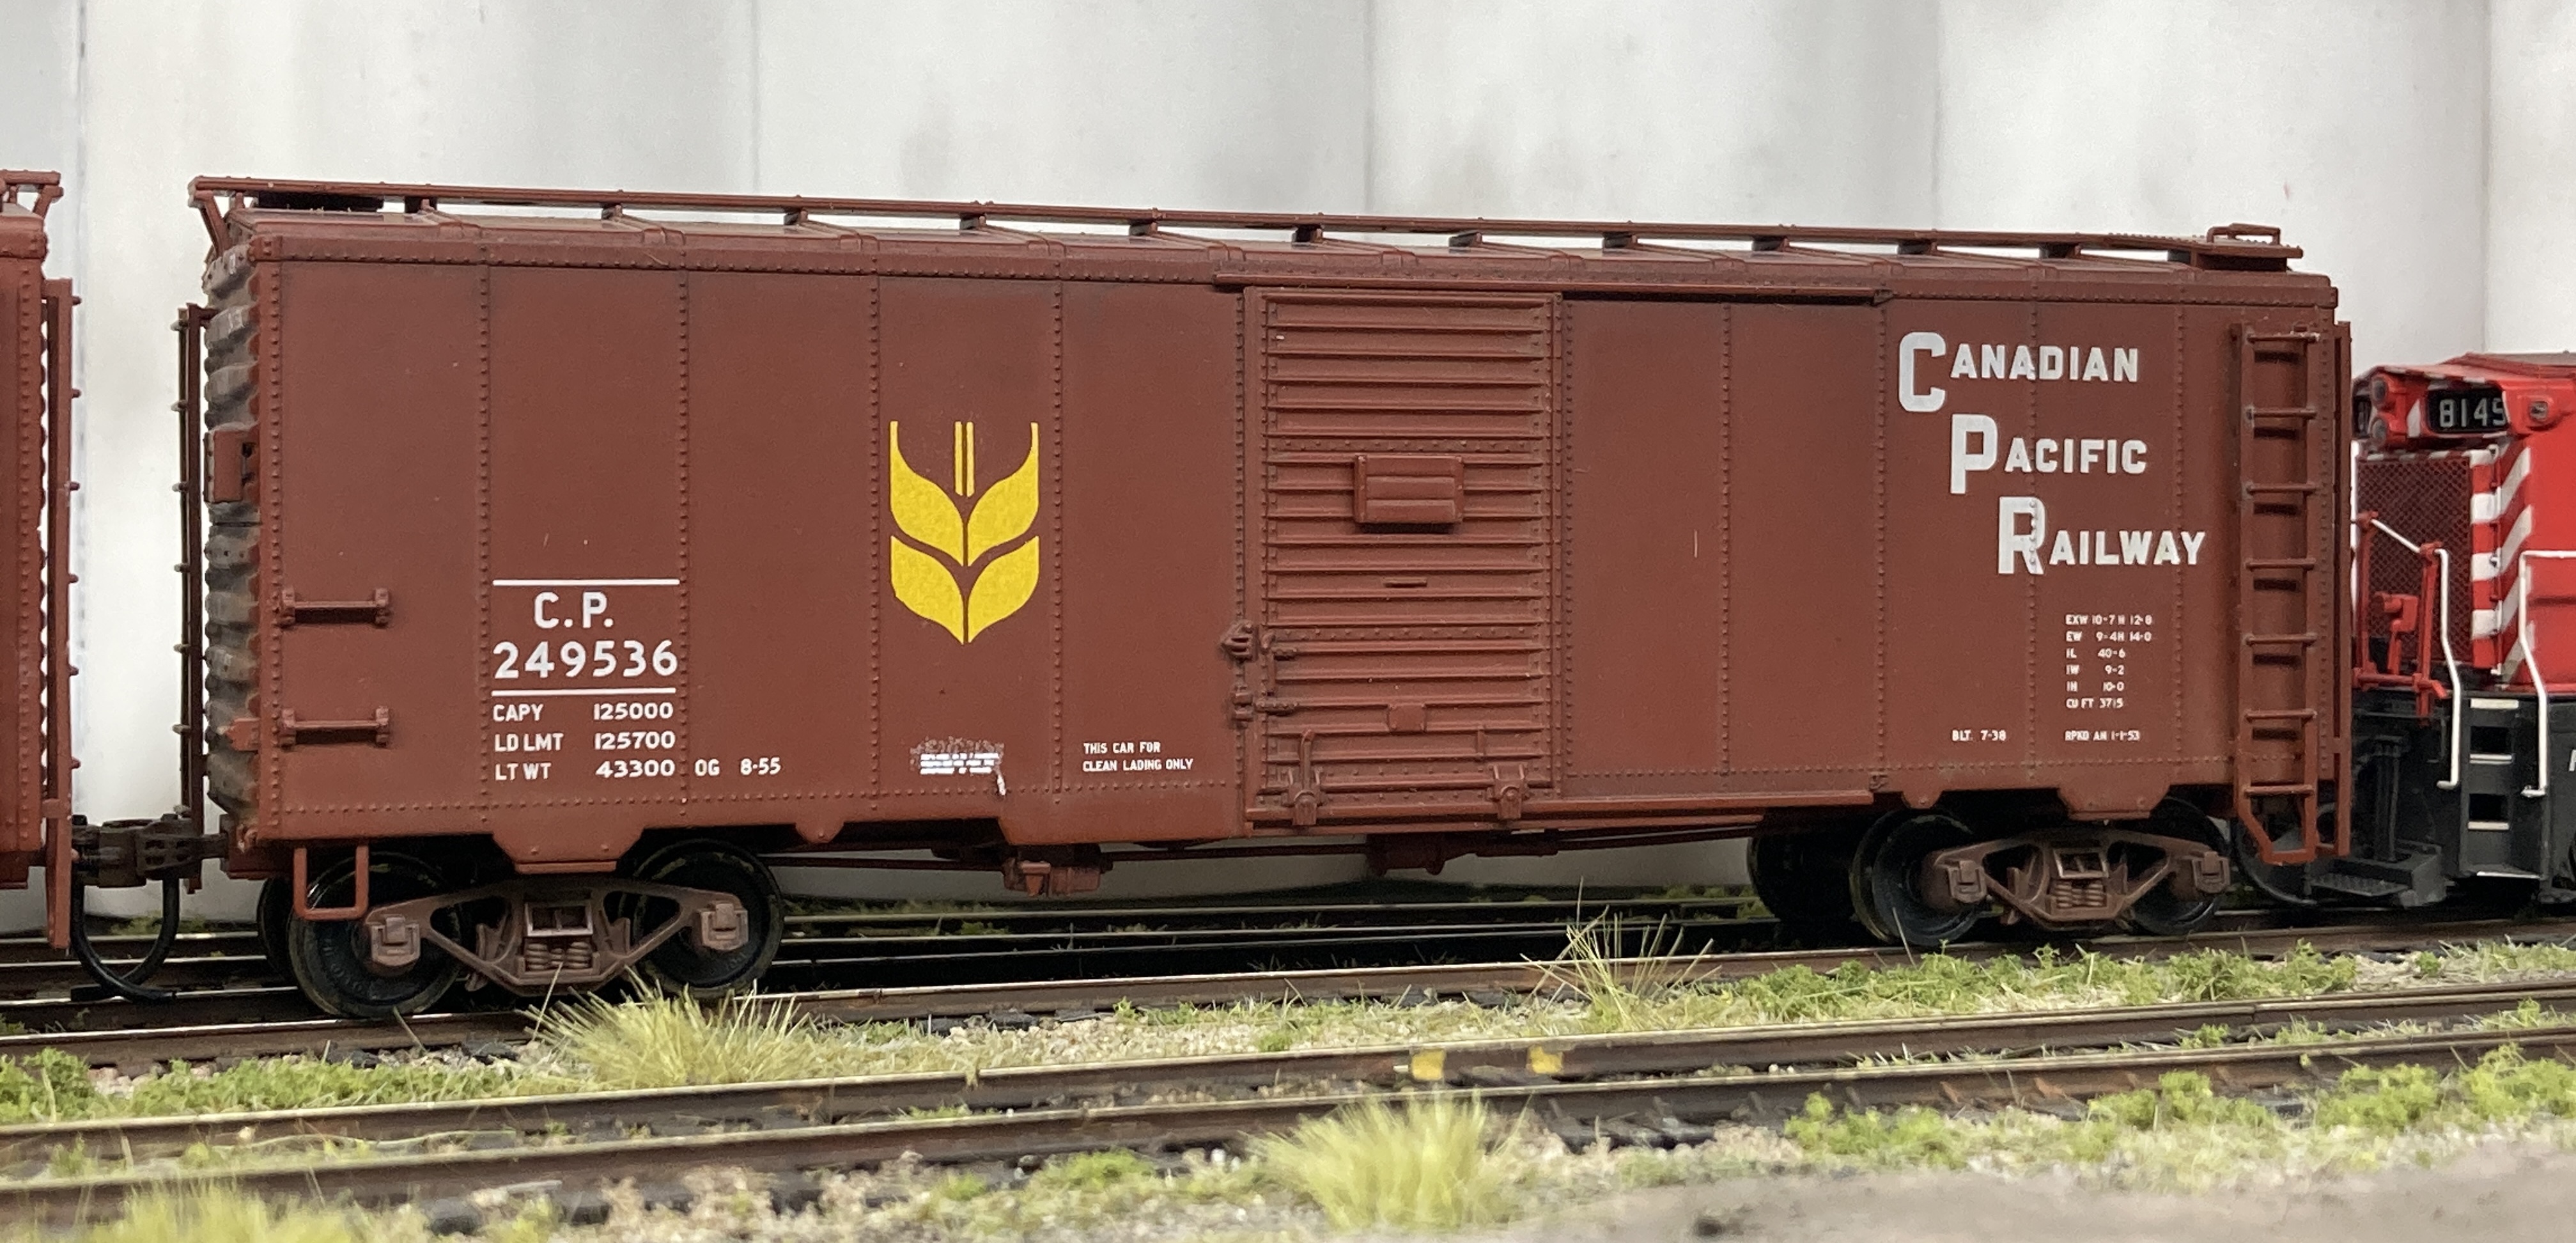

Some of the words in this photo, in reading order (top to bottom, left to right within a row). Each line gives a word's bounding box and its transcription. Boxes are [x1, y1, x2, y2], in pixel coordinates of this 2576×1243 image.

[1898, 332, 2138, 412] CANADIAN
[1950, 414, 2147, 494] PACIFIC
[1998, 496, 2206, 575] RAILWAY
[534, 591, 614, 629] C.P.
[2065, 614, 2089, 625] EXW
[2091, 614, 2115, 625] 10-7
[2066, 630, 2083, 642] EW
[493, 639, 678, 679] 249536
[2066, 648, 2077, 659] IL
[2097, 648, 2126, 659] 40-6
[2066, 664, 2081, 675] IW
[2104, 664, 2125, 676] 9-2
[2067, 680, 2078, 692] IH
[2081, 698, 2095, 708] FT
[2099, 697, 2124, 708] 3715
[493, 703, 544, 722] CAPY
[593, 701, 674, 721] 125000
[494, 733, 519, 753] LD
[523, 732, 564, 752] LMT
[594, 730, 676, 750] 125700
[1083, 742, 1108, 754] THIS
[1112, 742, 1135, 754] CAR
[1139, 741, 1161, 753] FOR
[495, 762, 518, 781] LT
[523, 762, 552, 780] WT
[595, 759, 676, 779] 43300
[694, 758, 720, 776] OG
[1082, 760, 1118, 772] CLEAN
[1122, 758, 1162, 771] LADING
[1165, 758, 1194, 770] ONLY
